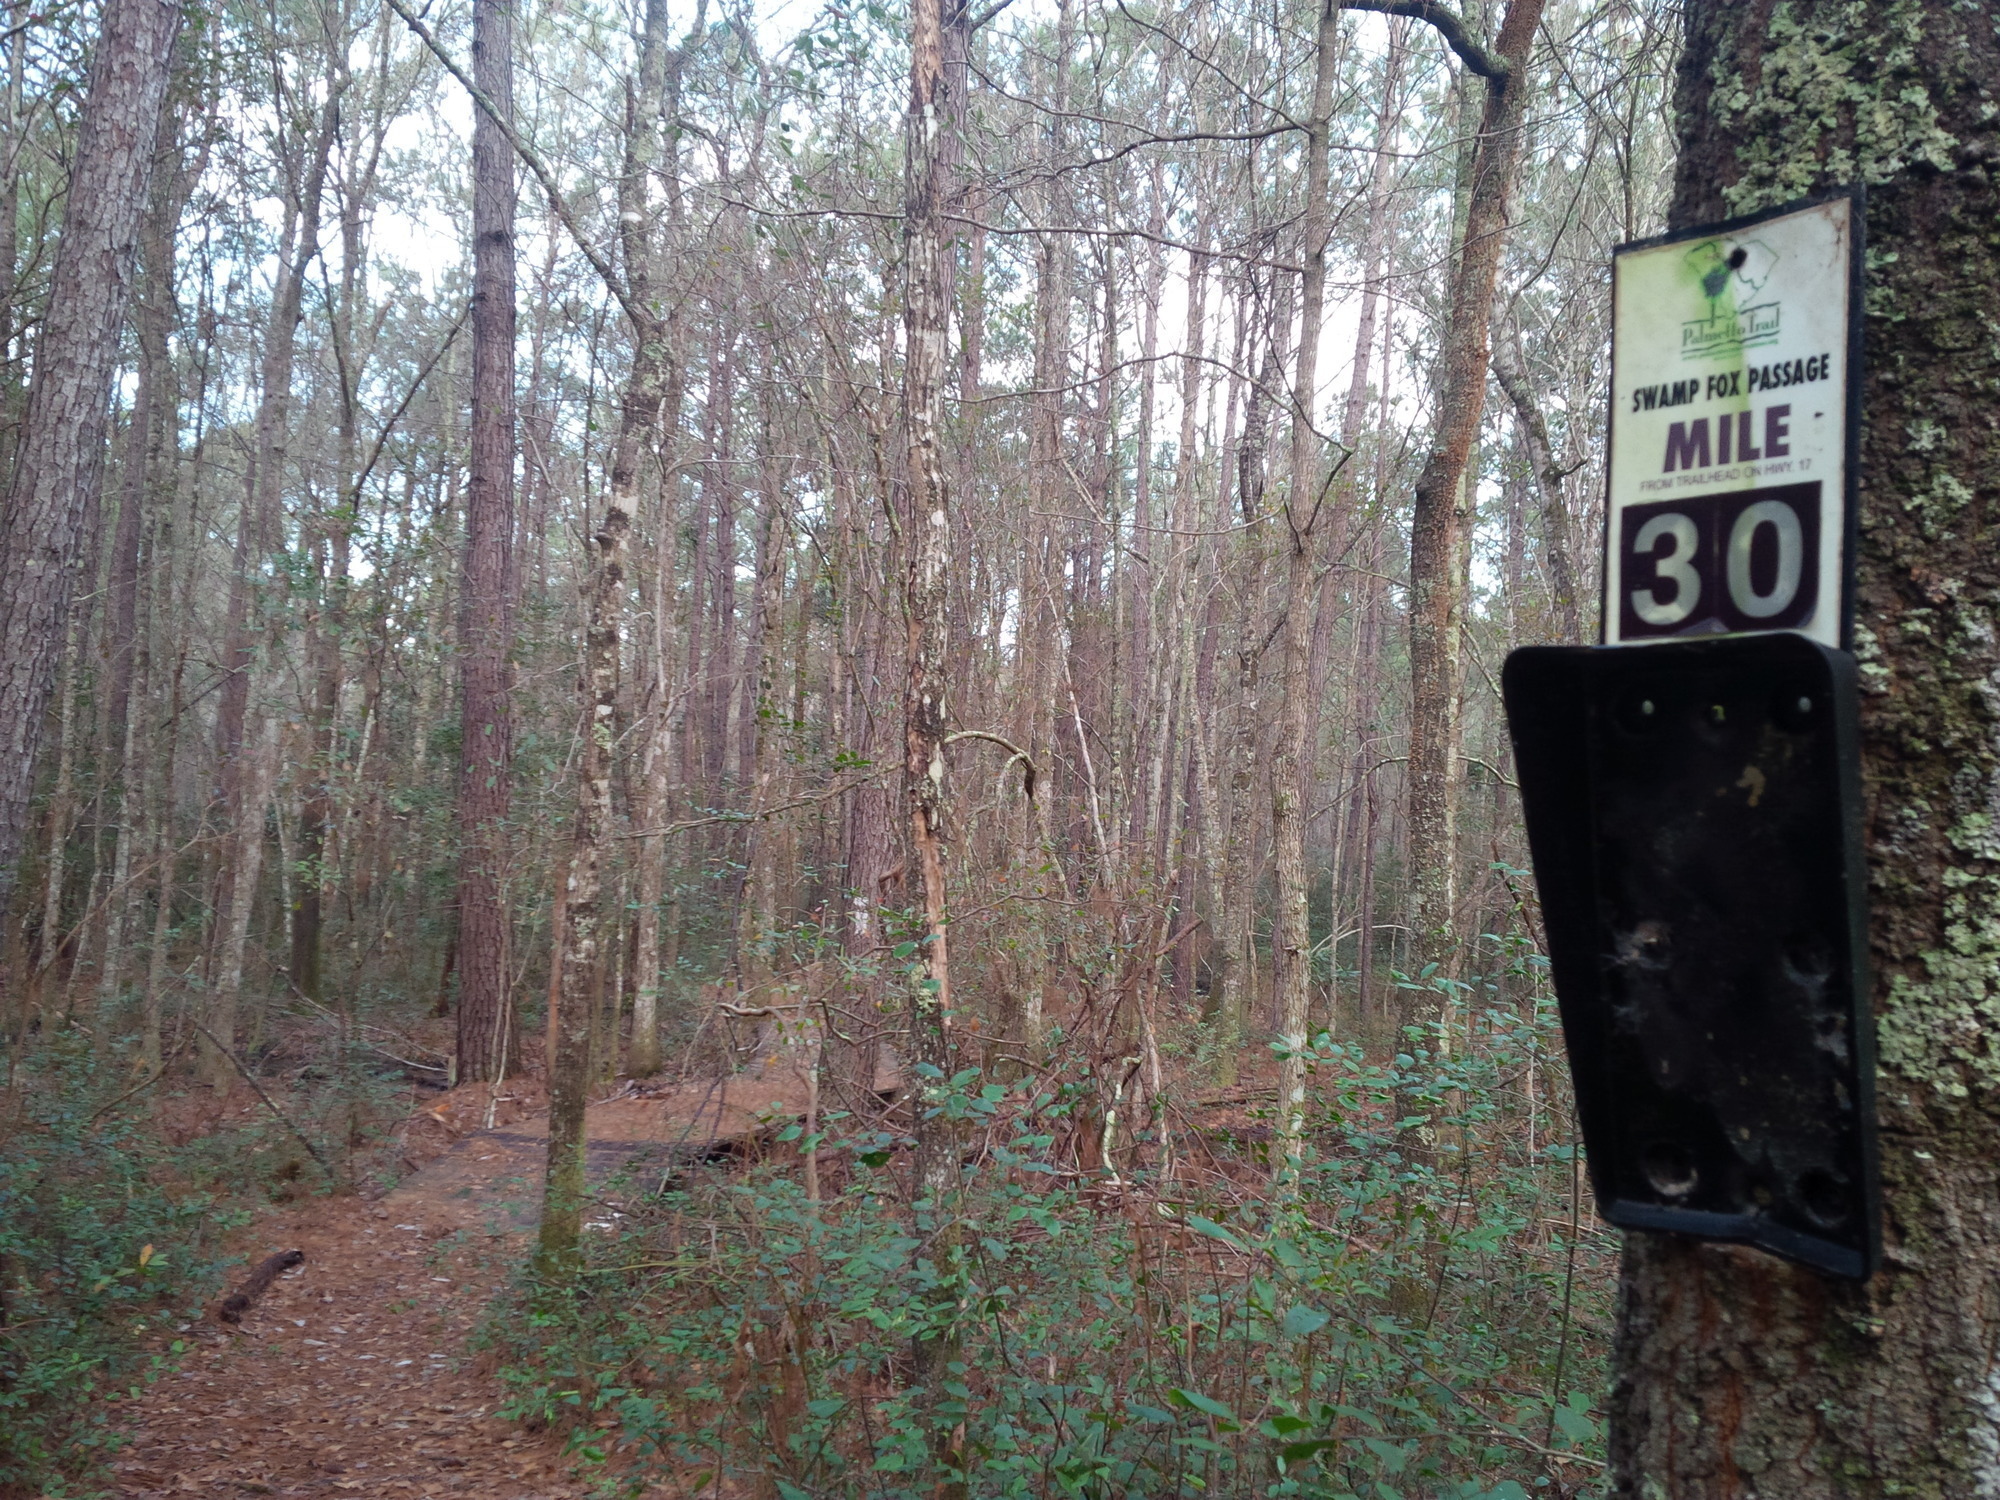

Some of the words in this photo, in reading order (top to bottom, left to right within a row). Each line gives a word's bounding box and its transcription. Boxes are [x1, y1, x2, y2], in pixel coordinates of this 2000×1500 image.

[1682, 322, 1746, 347] Palmetto
[1748, 307, 1780, 333] Trail
[1632, 379, 1700, 413] SWAMP
[1706, 371, 1742, 401] FOX
[1748, 353, 1831, 394] PASSAGE
[1662, 403, 1792, 473] MILE
[1639, 477, 1674, 492] FROM
[1676, 467, 1741, 487] TRAILHEAD
[1744, 465, 1762, 479] ON
[1799, 458, 1812, 471] 17
[1630, 500, 1804, 626] 30
